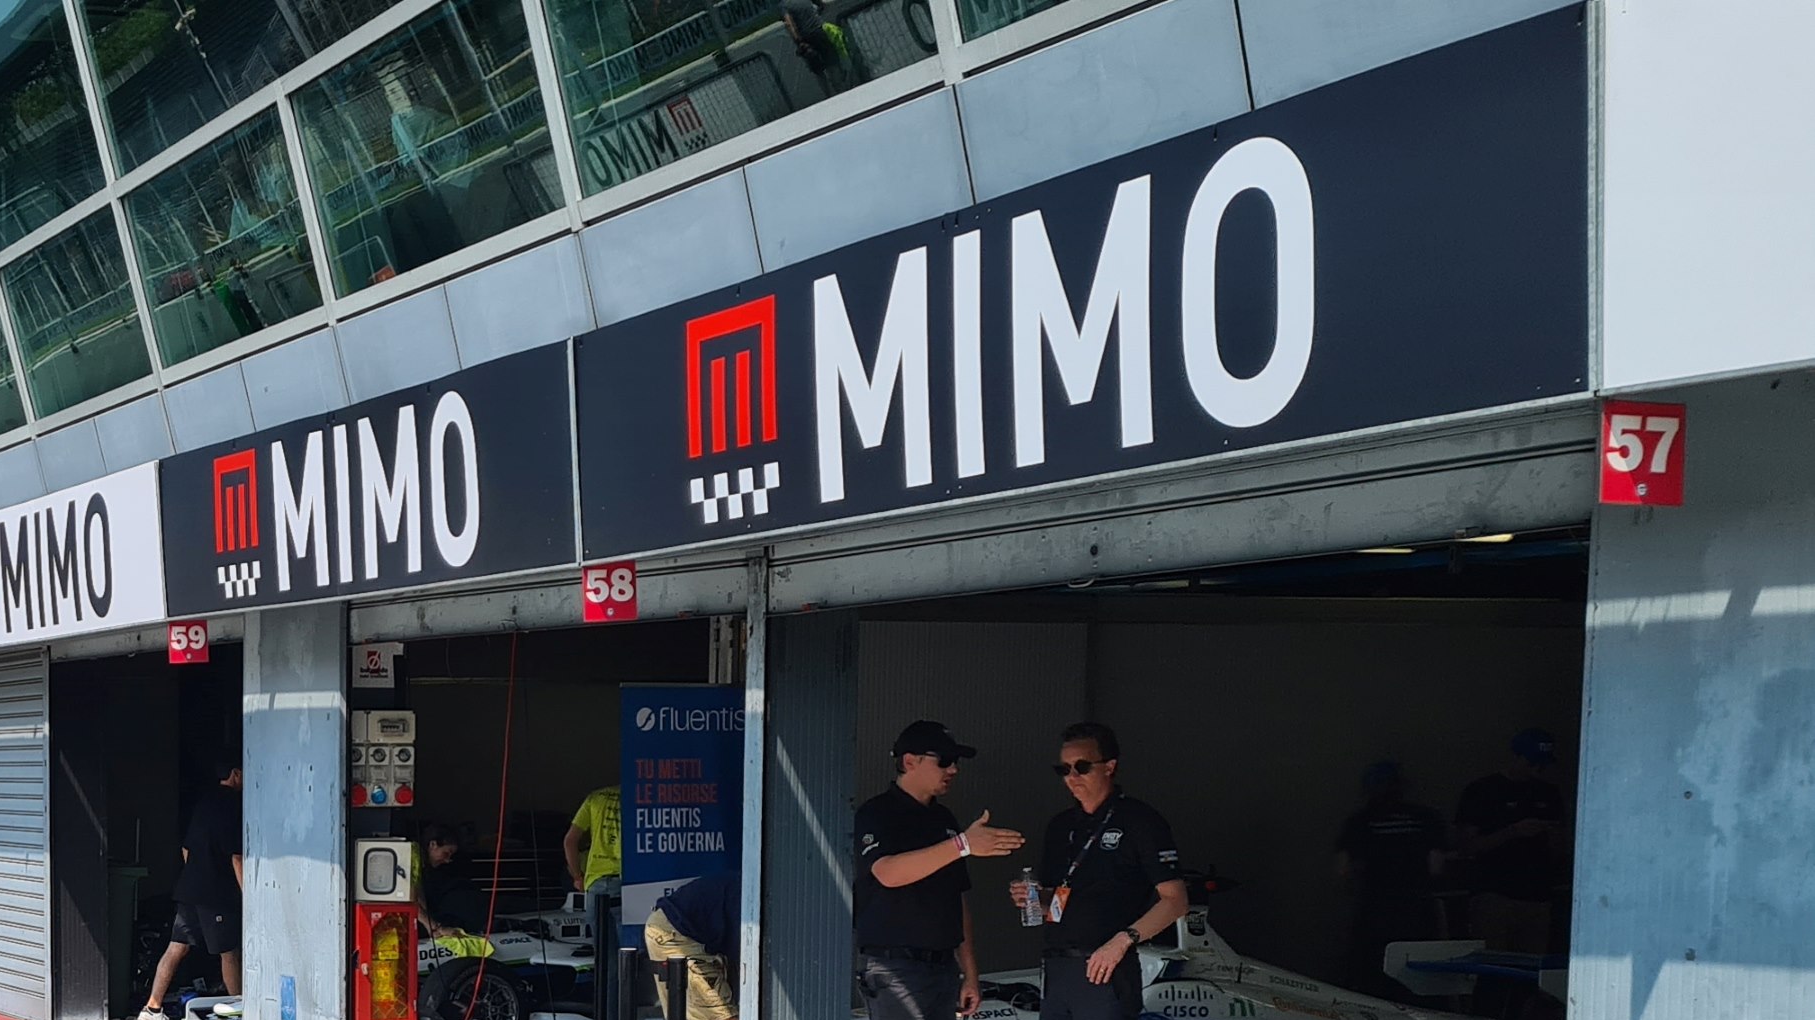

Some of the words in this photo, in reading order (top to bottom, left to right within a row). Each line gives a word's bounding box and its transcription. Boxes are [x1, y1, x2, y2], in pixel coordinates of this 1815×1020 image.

[813, 136, 1315, 503] MIMO
[1605, 414, 1680, 474] 57
[271, 391, 479, 591] MIMO
[0, 492, 114, 633] MIMO
[585, 568, 635, 603] 58
[170, 624, 208, 651] 59
[659, 706, 746, 732] fluentis
[636, 759, 654, 779] TU
[658, 758, 702, 779] METTI
[636, 783, 653, 803] LE
[658, 783, 718, 803] RISORSE
[636, 807, 701, 829] FLUENTIS
[637, 833, 653, 853] LE
[658, 831, 725, 853] GOVERNA
[972, 1007, 1016, 1020] dSPACE
[1163, 1005, 1209, 1018] CISCO
